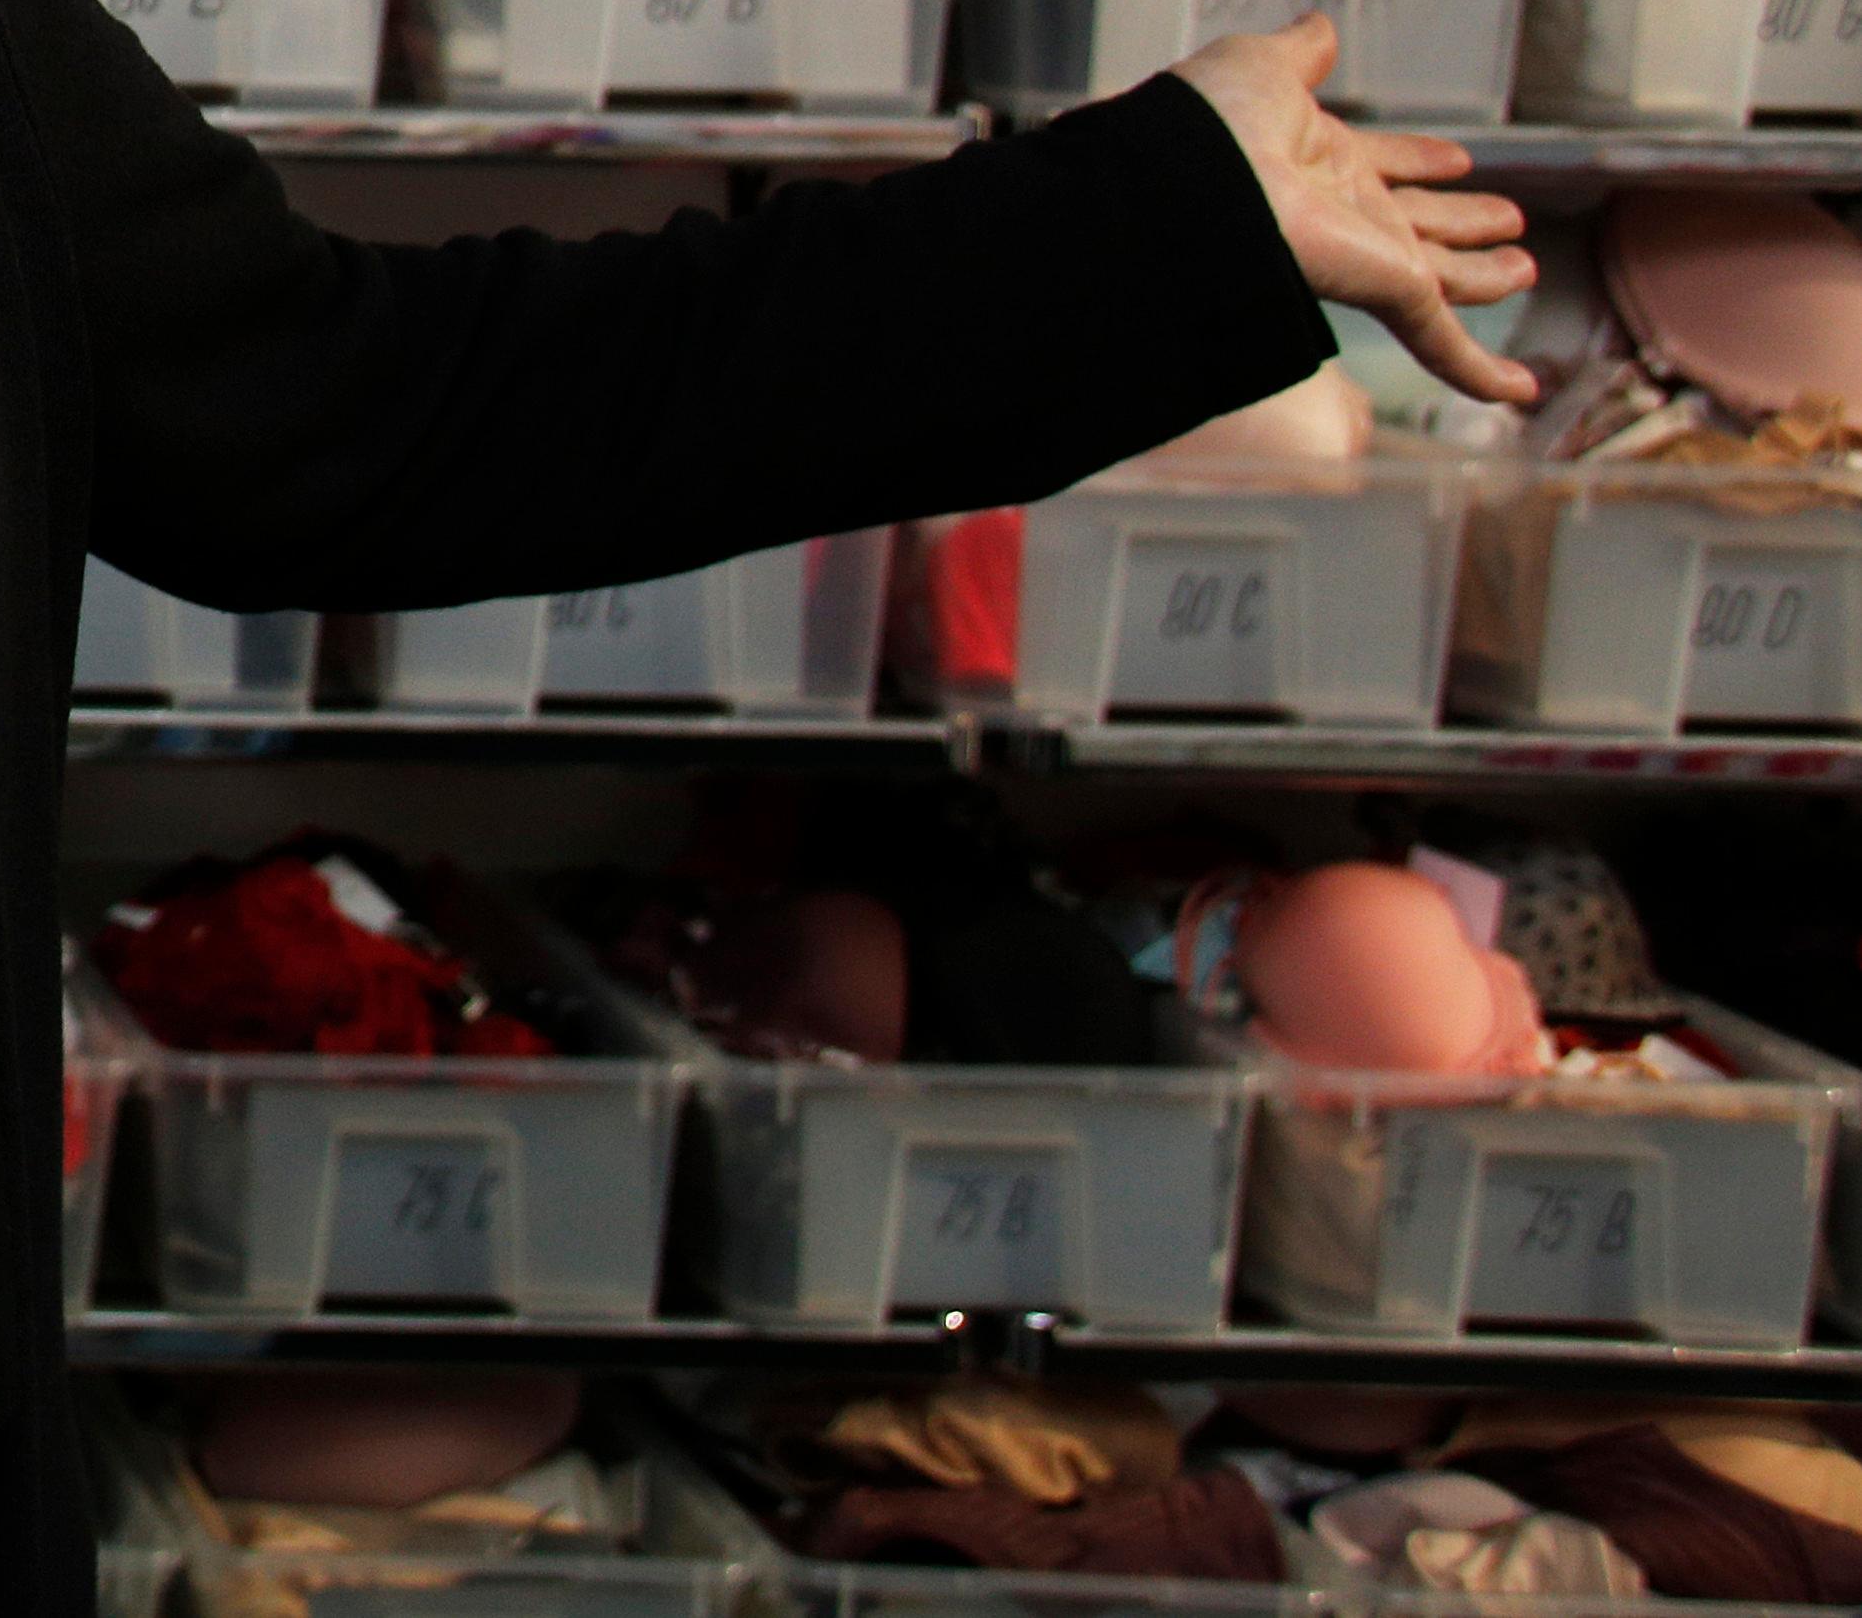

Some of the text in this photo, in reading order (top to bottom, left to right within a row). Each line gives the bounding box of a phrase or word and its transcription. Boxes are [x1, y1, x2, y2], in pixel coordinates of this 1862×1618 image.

[1689, 584, 1756, 652] 80
[1514, 1184, 1639, 1256] 75 B
